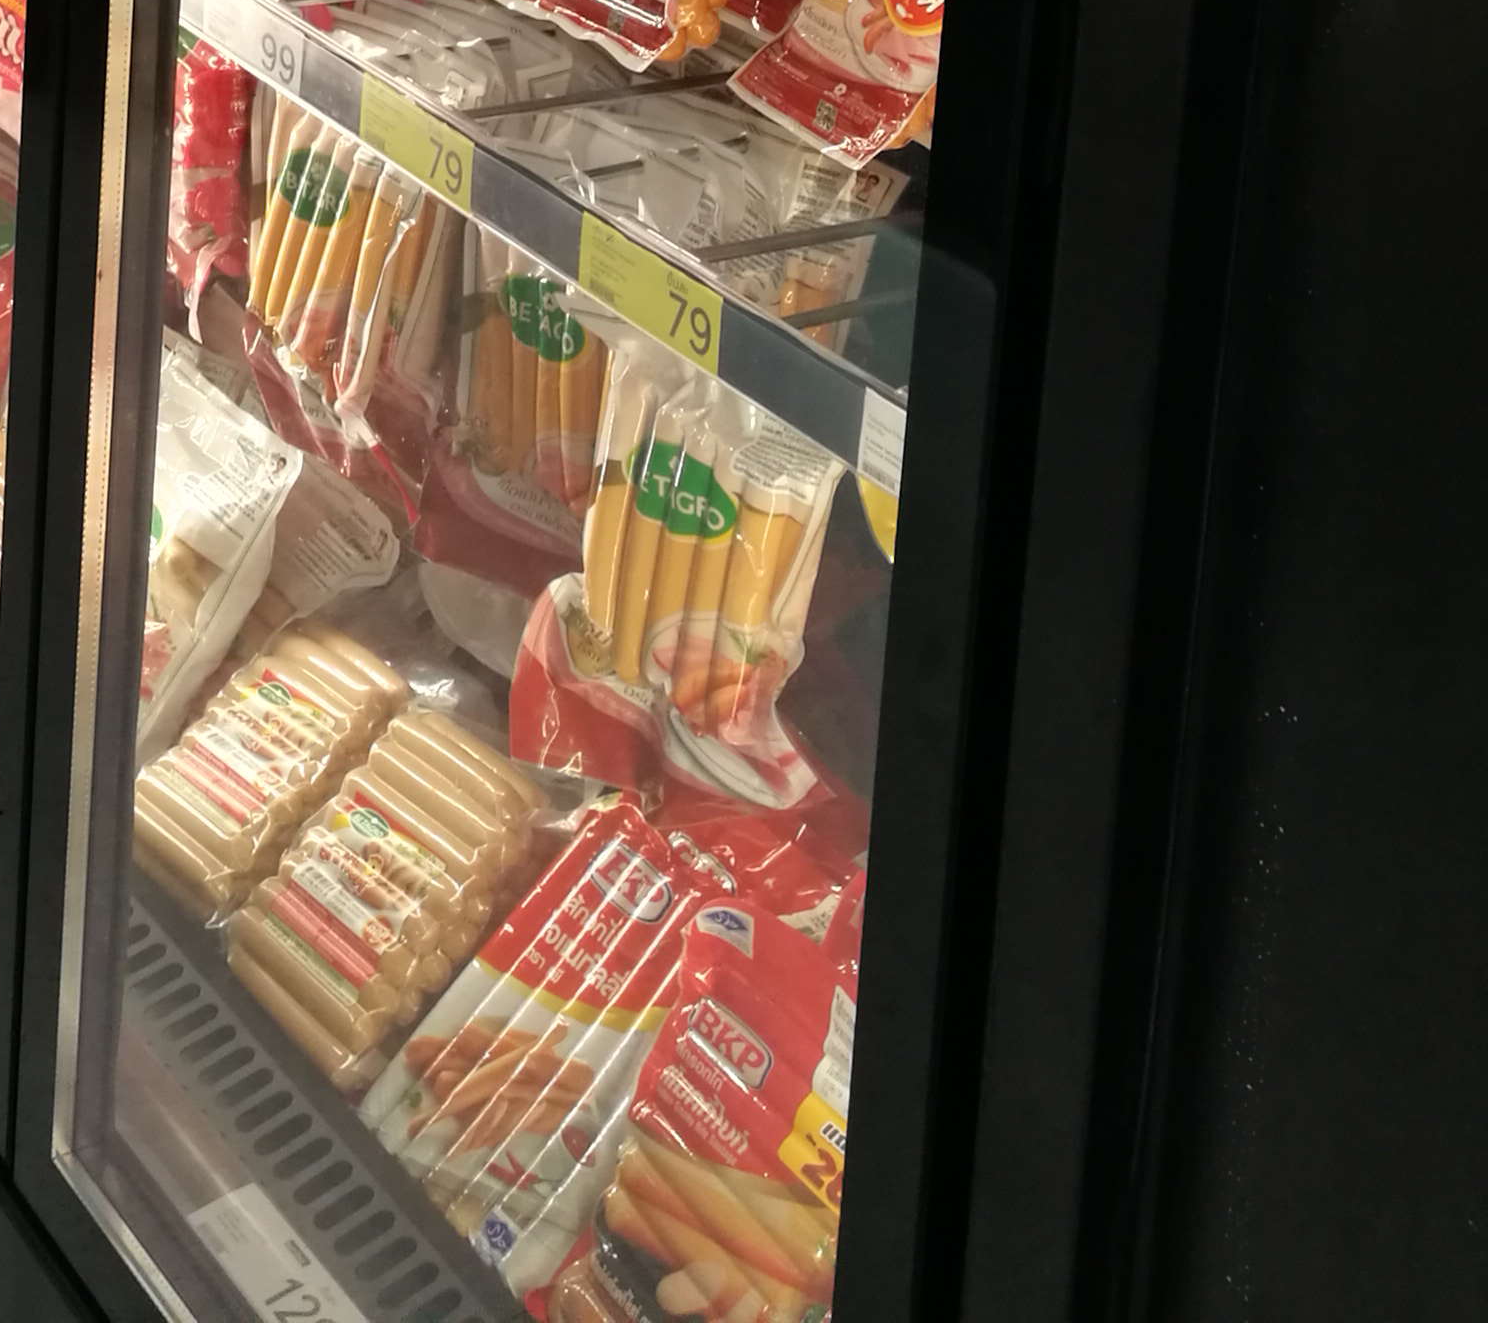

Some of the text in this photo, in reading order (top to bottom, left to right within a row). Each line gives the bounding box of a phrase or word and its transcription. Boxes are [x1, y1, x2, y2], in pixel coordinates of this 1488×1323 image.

[261, 34, 296, 85] 99
[428, 138, 463, 195] 79
[668, 291, 712, 356] 79
[694, 1001, 766, 1077] BKP
